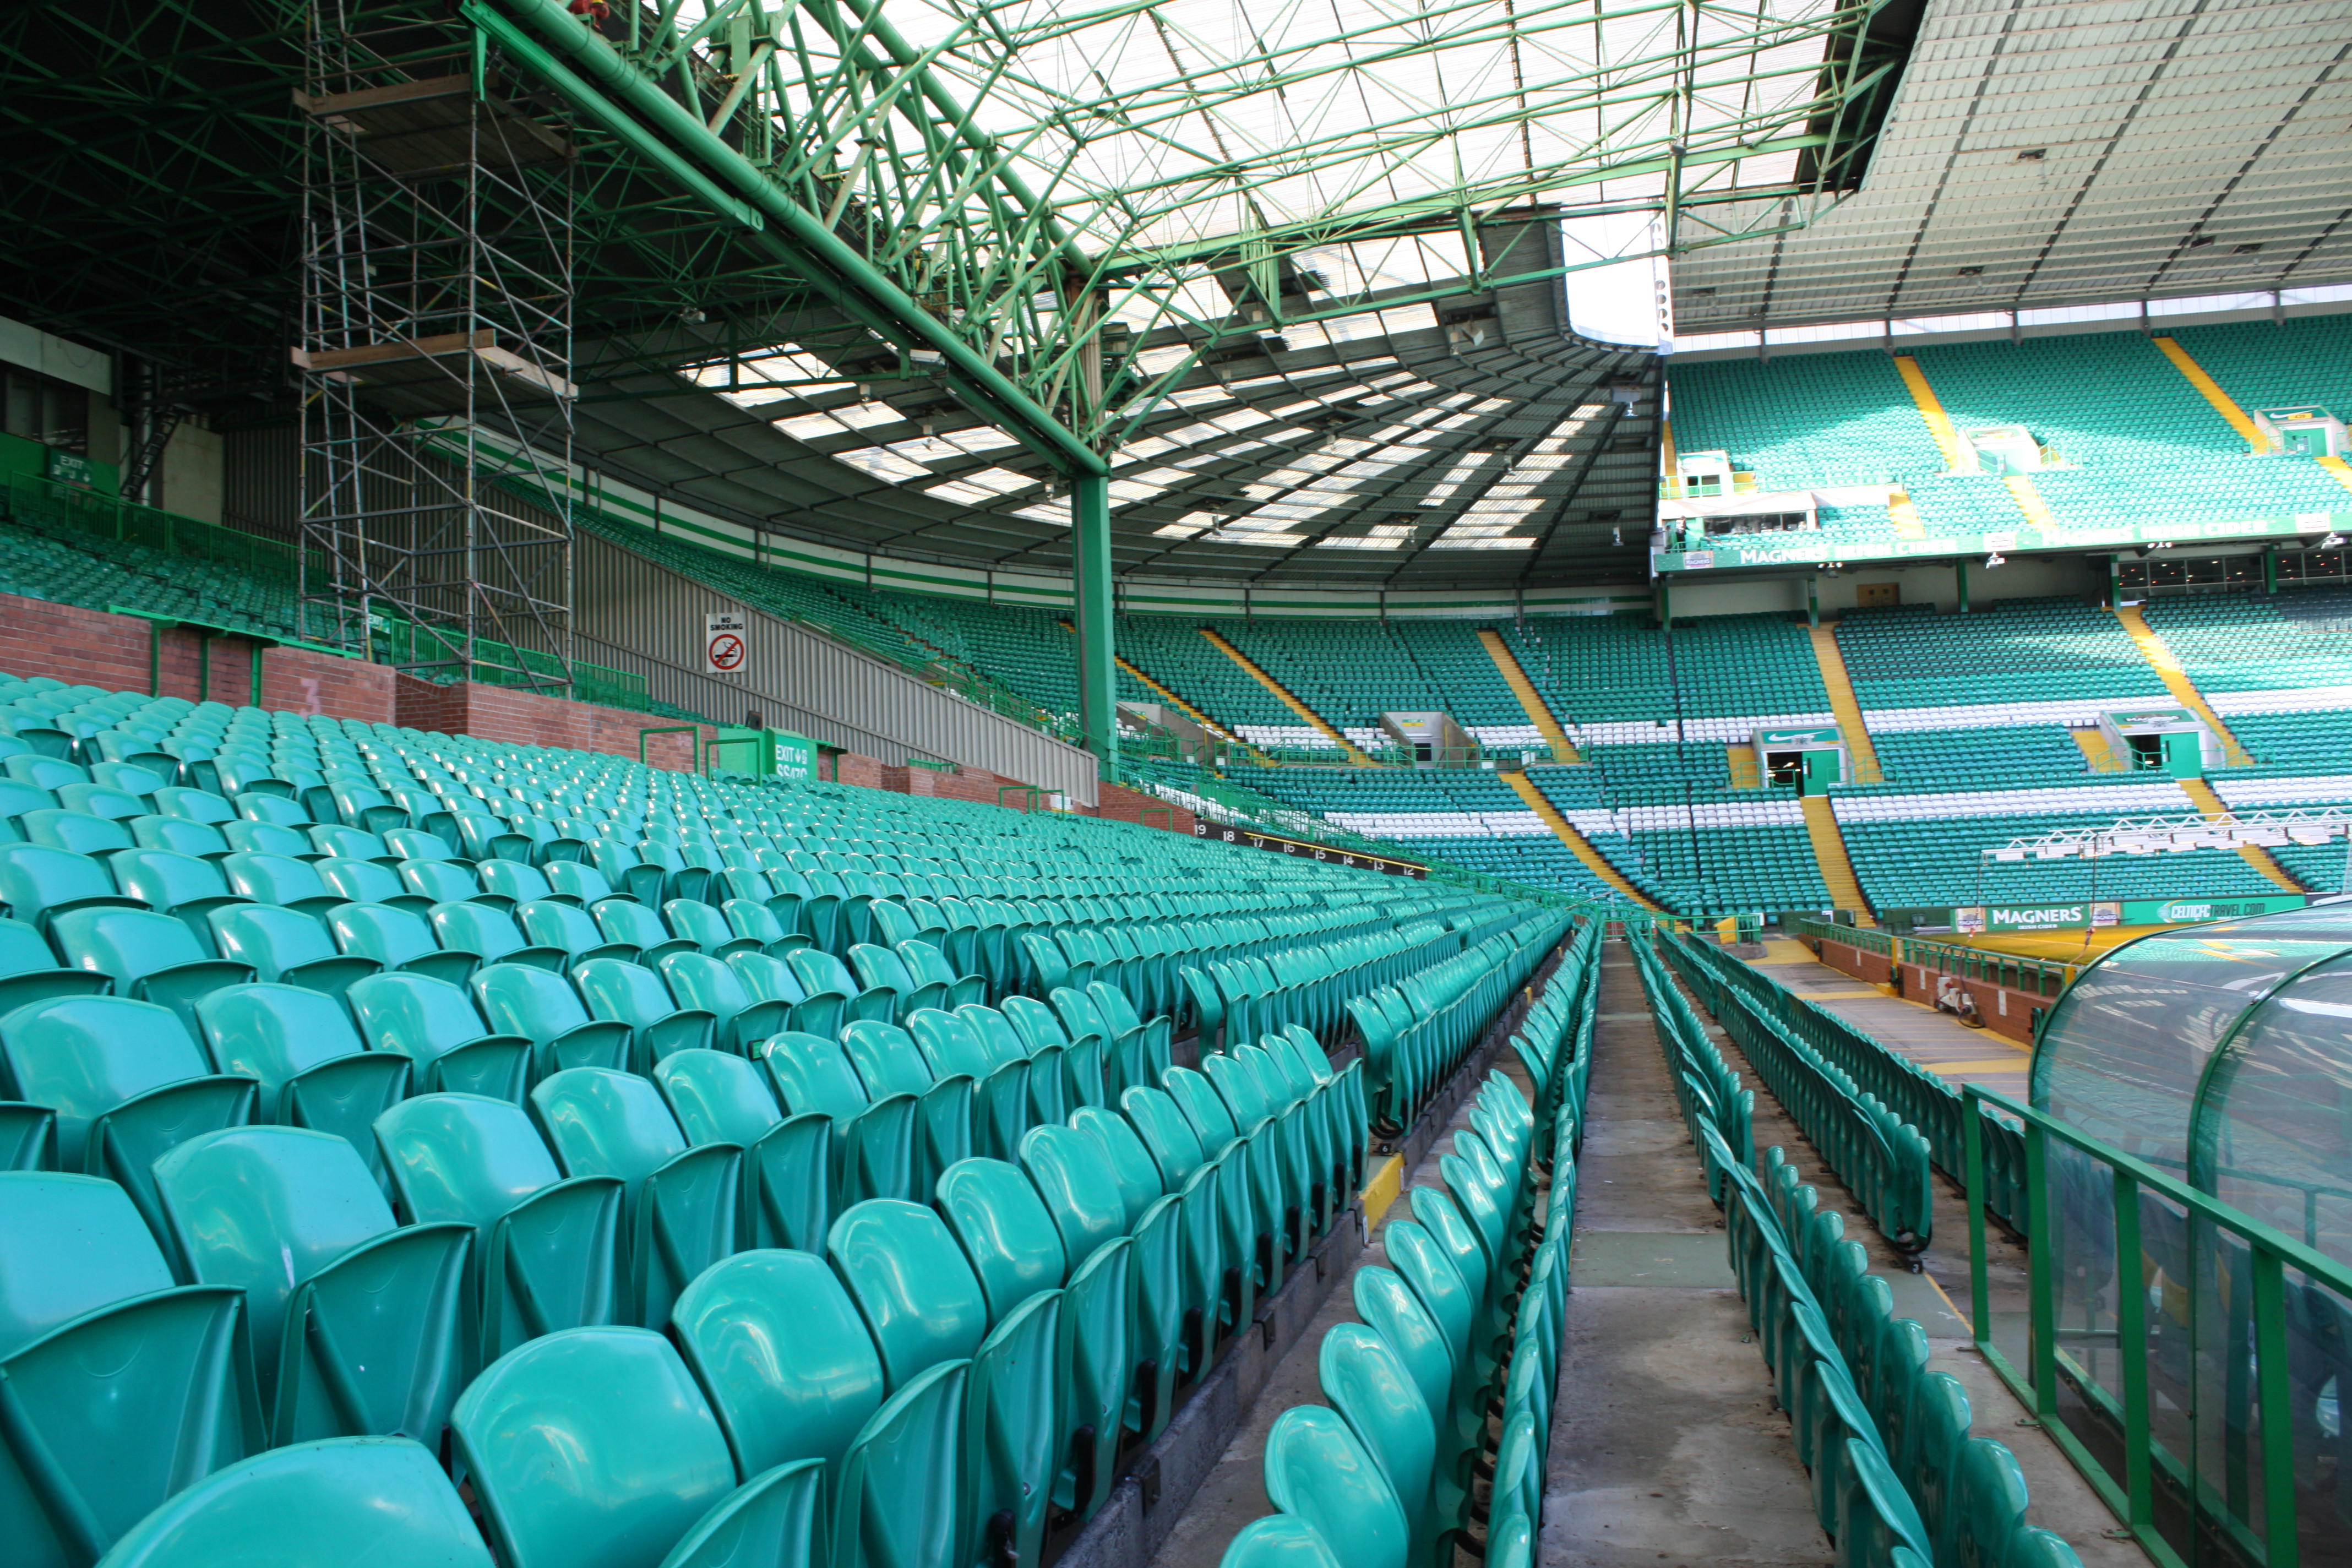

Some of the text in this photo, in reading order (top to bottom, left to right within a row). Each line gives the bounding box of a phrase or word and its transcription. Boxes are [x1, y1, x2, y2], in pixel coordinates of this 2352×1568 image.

[60, 455, 84, 470] EXIT
[2204, 520, 2268, 535] CIDER
[1740, 543, 1828, 564] MAGNERS
[1896, 539, 1958, 555] CIDER
[775, 744, 794, 763] EXIT
[1195, 825, 1414, 875] 19 18 17 16 15 14 13 12
[1992, 906, 2083, 924] MAGNERS
